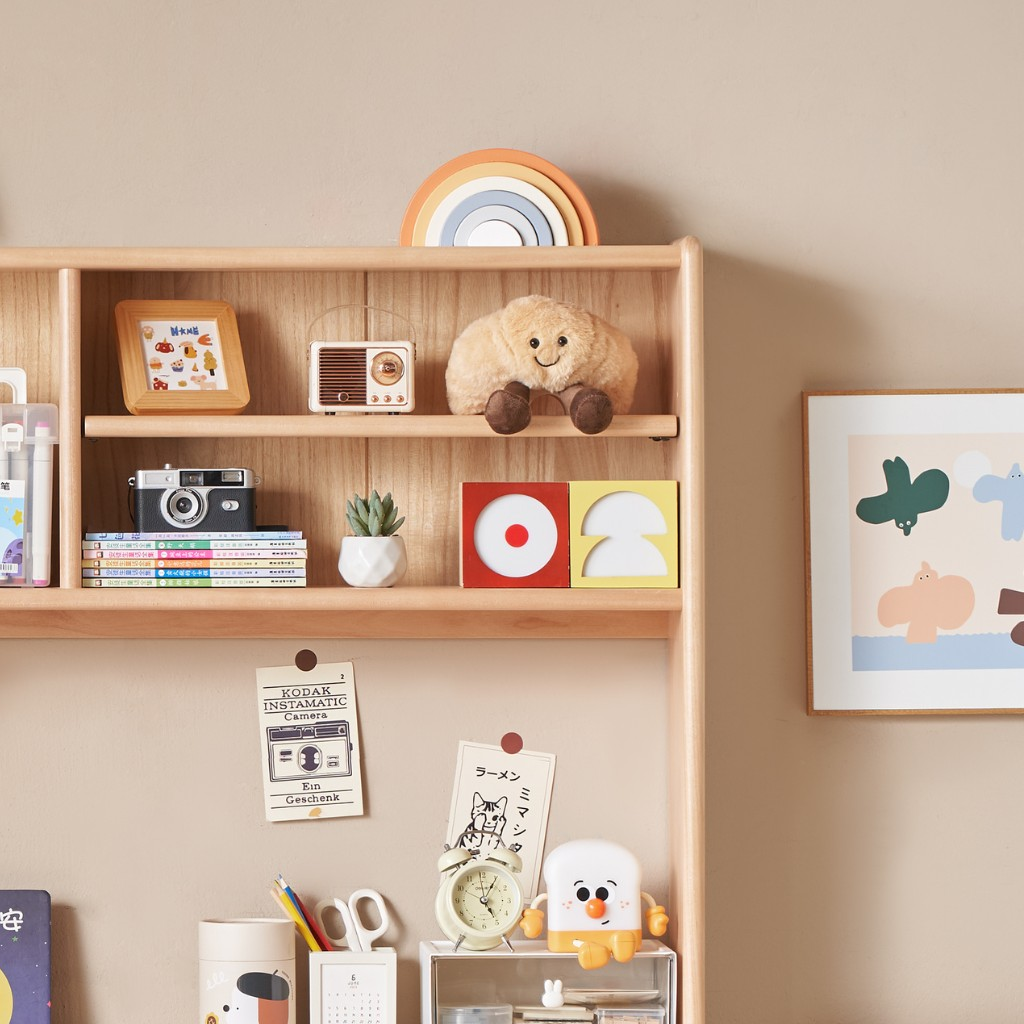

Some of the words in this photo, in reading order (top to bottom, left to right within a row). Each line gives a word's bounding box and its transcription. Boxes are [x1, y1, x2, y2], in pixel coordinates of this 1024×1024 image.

[281, 687, 331, 698] KODAK
[263, 697, 347, 711] INSTAMATIC
[284, 712, 328, 721] Camera
[475, 766, 520, 781] ラーメン
[302, 782, 320, 791] Ein
[286, 793, 340, 804] Geschenk
